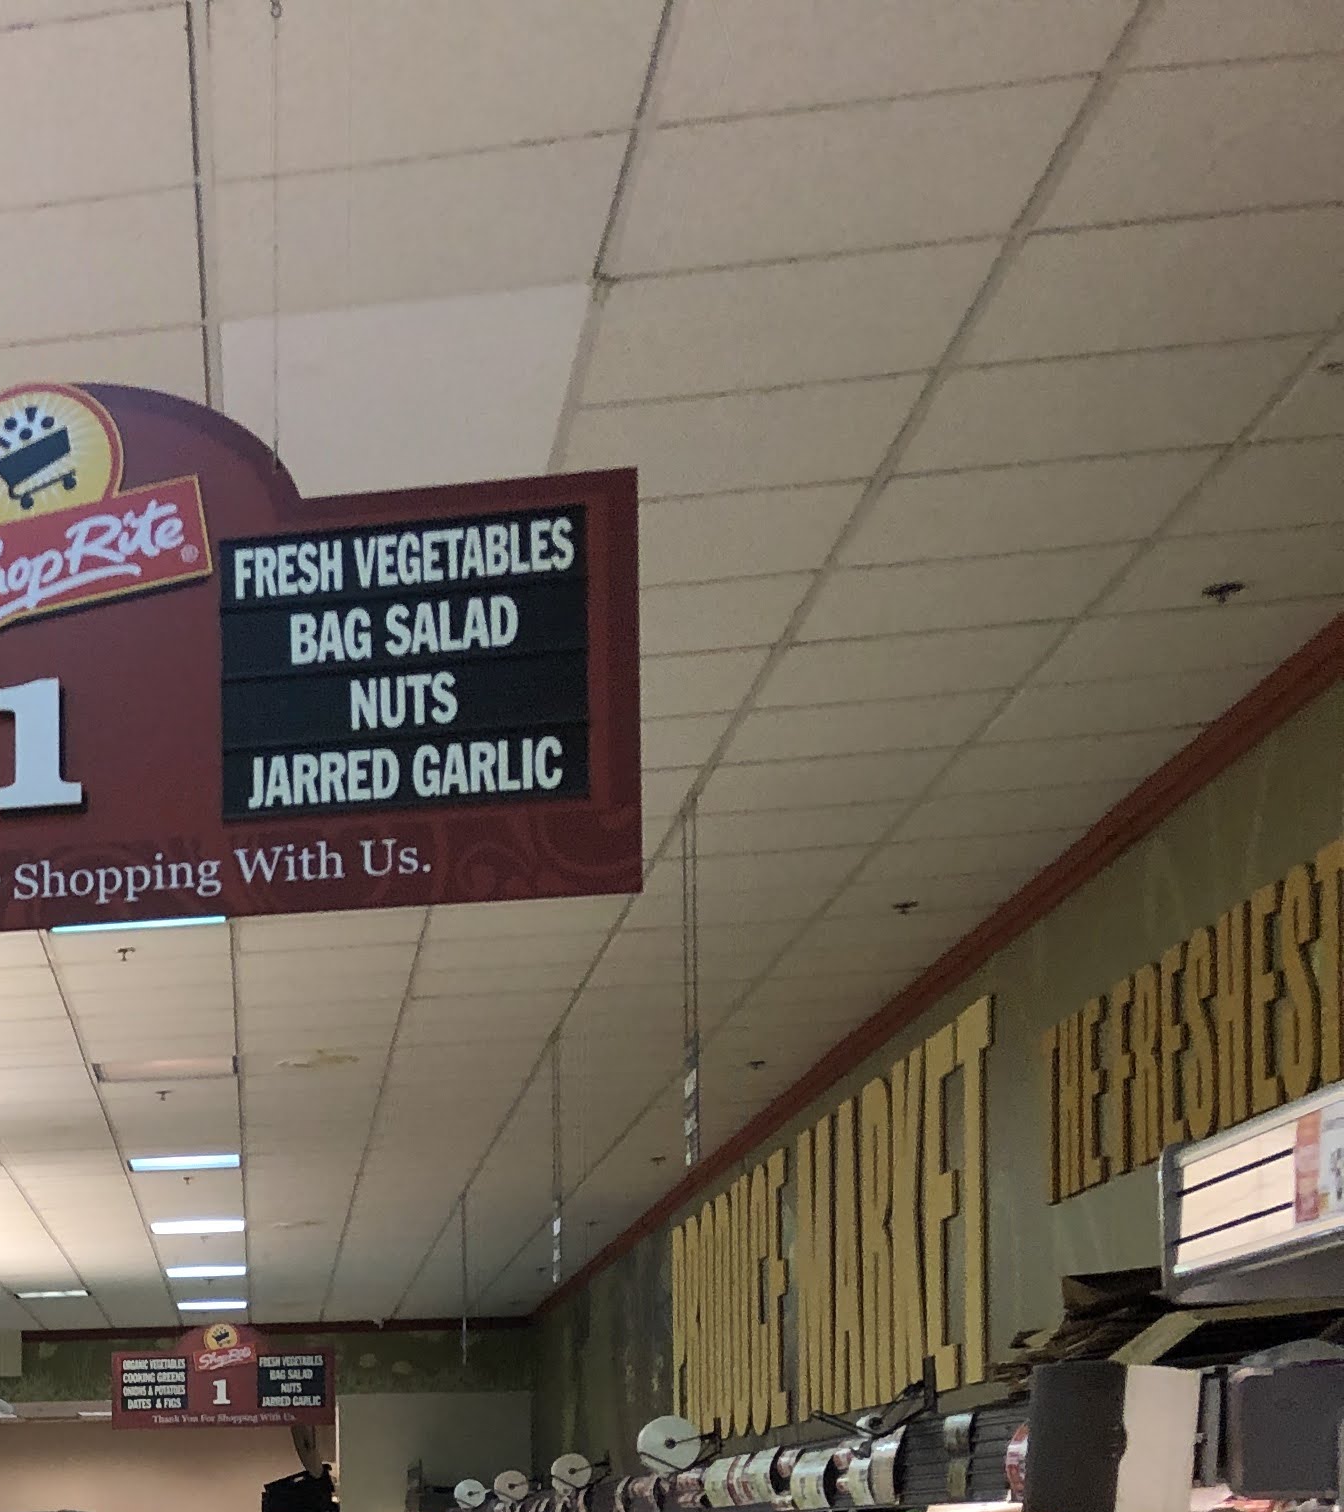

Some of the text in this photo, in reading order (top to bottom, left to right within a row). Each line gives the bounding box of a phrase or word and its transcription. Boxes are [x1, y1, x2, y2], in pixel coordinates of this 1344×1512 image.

[234, 517, 575, 600] FRESH VEGETABLES
[290, 595, 518, 665] BAG SALAD
[350, 671, 458, 731] NUTS
[248, 736, 562, 810] JARRED GARLIC
[12, 853, 222, 906] Shopping
[234, 841, 345, 887] With
[360, 838, 432, 878] Us.
[1042, 836, 1344, 1206] THE FRESHEST
[672, 995, 994, 1438] PRODUCE MARKET
[123, 1358, 185, 1371] ORGANIC VEGETABLES
[198, 1347, 252, 1369] ShopRite
[259, 1355, 323, 1367] FRESH VEGETABLES
[123, 1372, 185, 1383] COOKING GREENS
[269, 1369, 313, 1380] BAG SALAD
[123, 1386, 146, 1396] ONIONS
[155, 1384, 185, 1395] POTATOES
[213, 1379, 231, 1405] 1
[280, 1382, 302, 1393] NUTS
[127, 1398, 151, 1410] DATES
[164, 1398, 181, 1408] FIGS
[262, 1395, 322, 1407] JARRED GARLIC
[152, 1415, 180, 1423] Thank
[182, 1415, 198, 1423] You
[200, 1414, 215, 1422] For
[218, 1414, 258, 1424] Shopping
[260, 1413, 281, 1422] With
